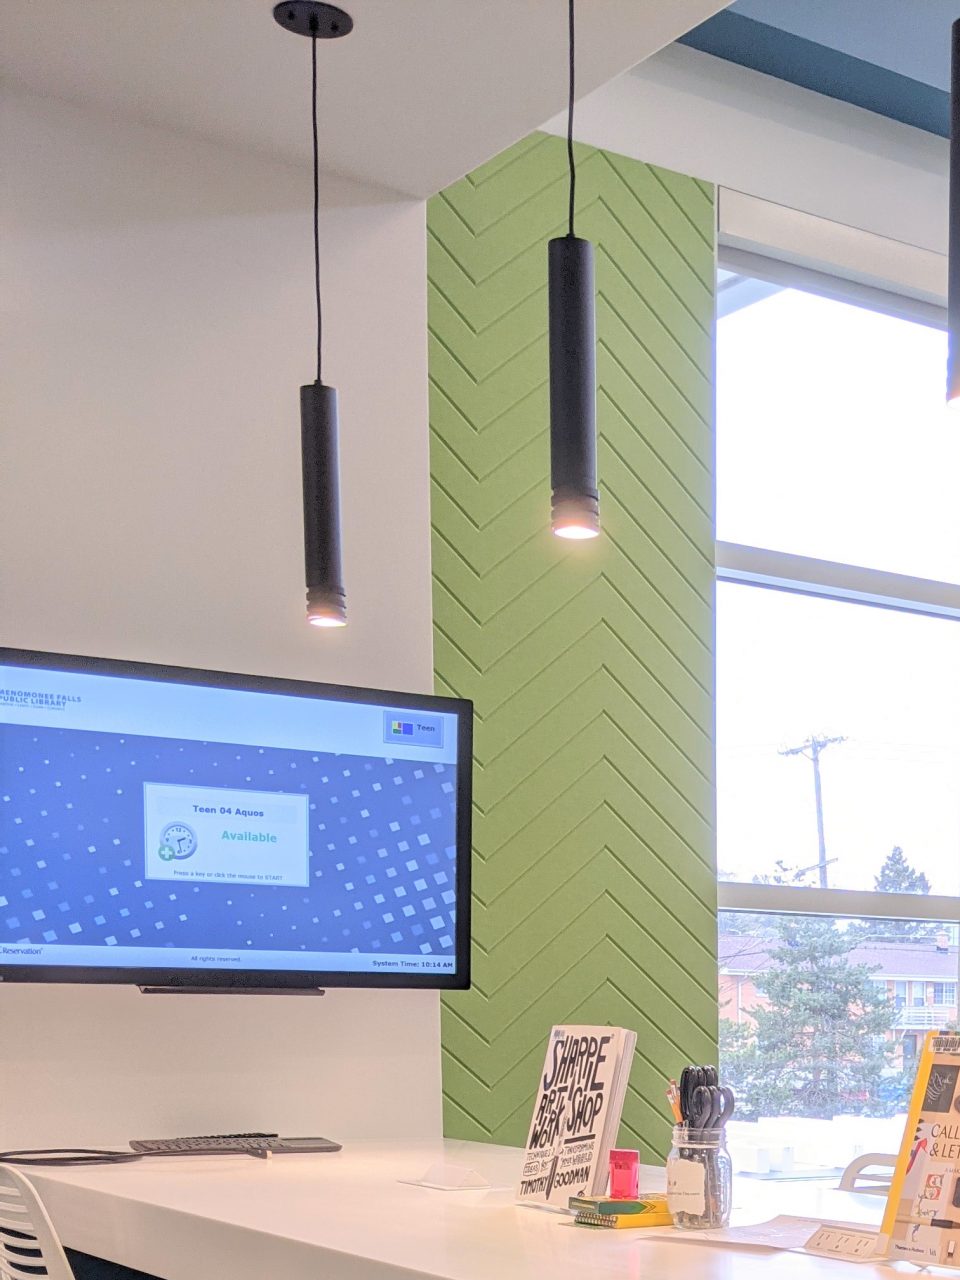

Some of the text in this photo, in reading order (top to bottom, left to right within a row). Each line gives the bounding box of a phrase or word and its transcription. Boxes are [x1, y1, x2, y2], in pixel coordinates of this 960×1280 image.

[31, 698, 66, 707] LIBRARY
[57, 694, 82, 703] FALLS
[417, 724, 435, 732] Teen
[193, 805, 264, 818] Teen 04 Aquos
[221, 830, 277, 843] Available
[372, 960, 398, 968] System
[536, 1086, 568, 1120] ART
[567, 1086, 603, 1136] SHOP
[929, 1142, 939, 1157] &
[520, 1166, 591, 1195] TIMOTHY GOODMAN
